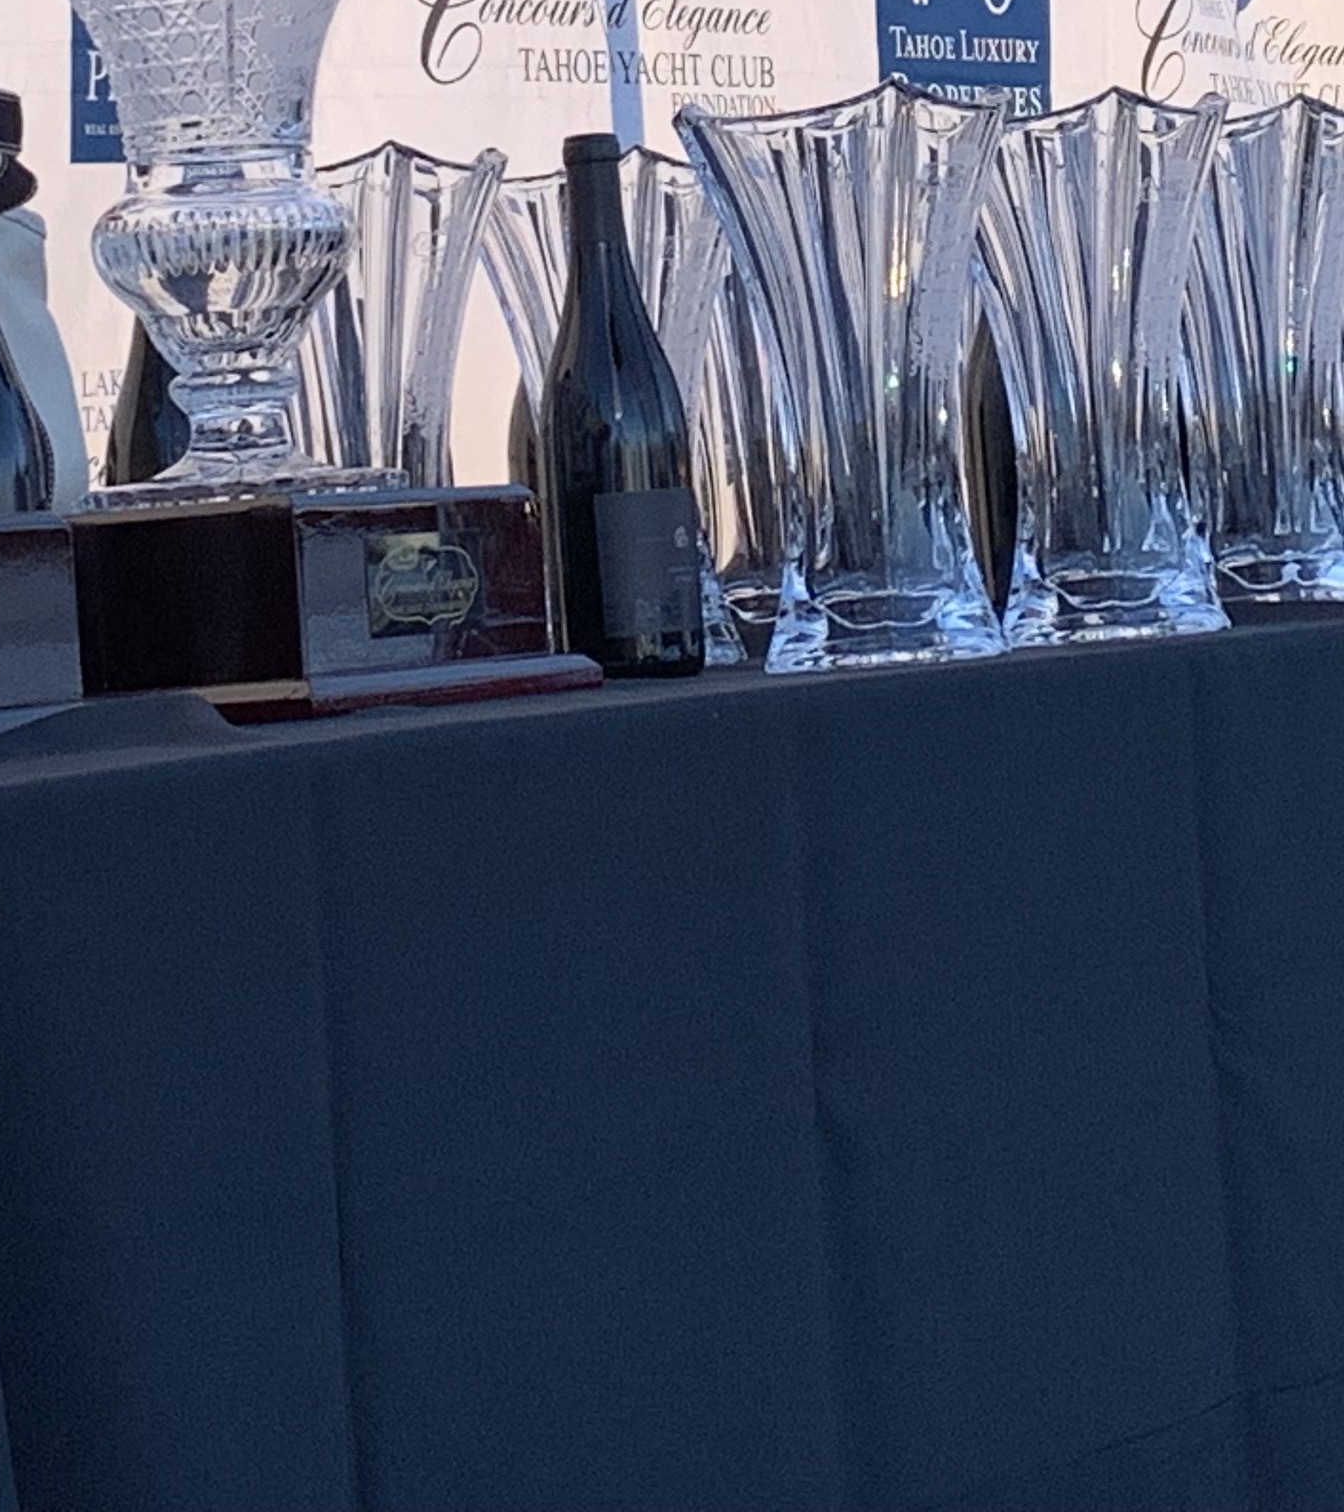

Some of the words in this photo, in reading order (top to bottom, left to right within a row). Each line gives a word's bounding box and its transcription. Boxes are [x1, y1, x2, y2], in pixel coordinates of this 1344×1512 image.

[889, 26, 955, 60] TAHOE
[960, 30, 1039, 63] LUXURY
[519, 47, 607, 84] TAHOE
[617, 50, 702, 86] YACHT
[712, 55, 775, 88] CLUB
